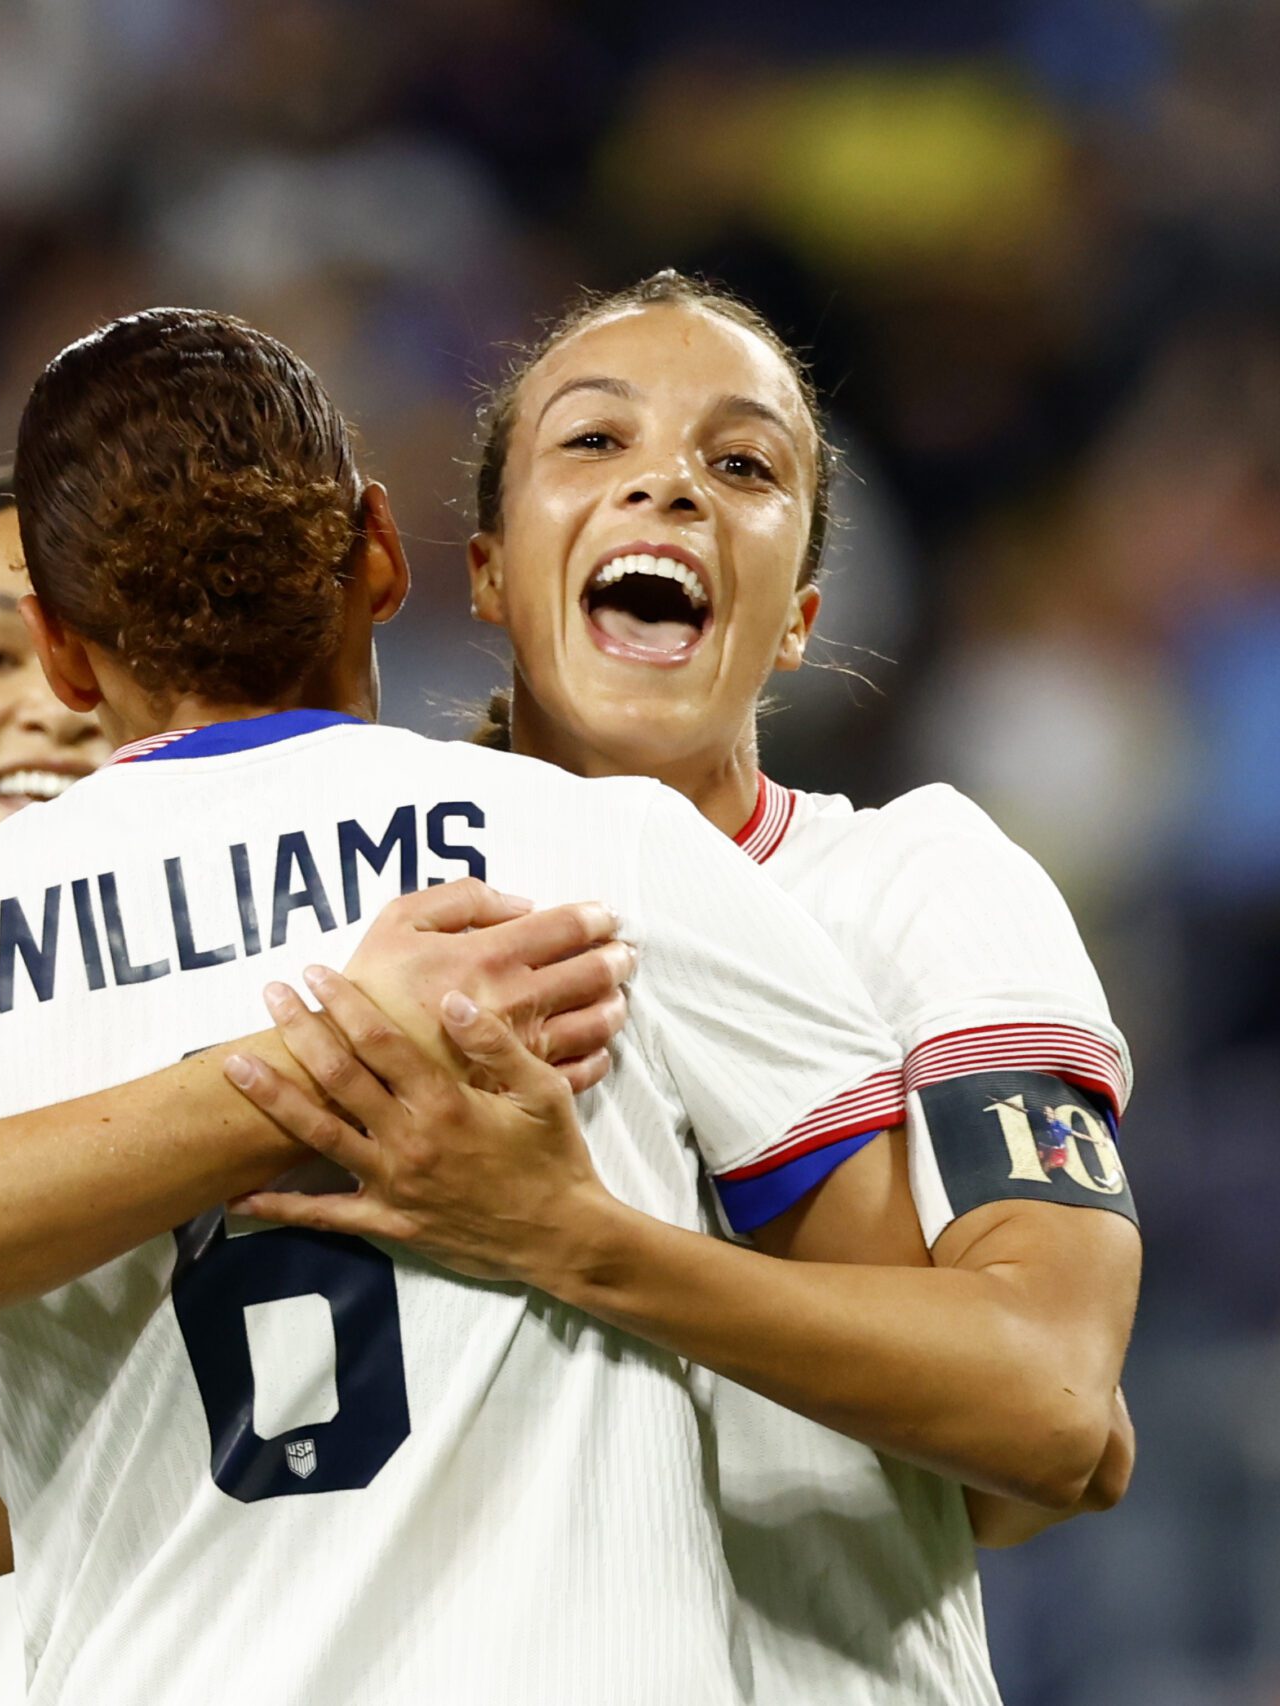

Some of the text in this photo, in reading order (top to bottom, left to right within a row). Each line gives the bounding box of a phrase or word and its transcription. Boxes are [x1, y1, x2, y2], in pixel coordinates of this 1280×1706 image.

[982, 1094, 1124, 1194] 10
[172, 1042, 412, 1504] 6
[288, 1441, 312, 1457] USA
